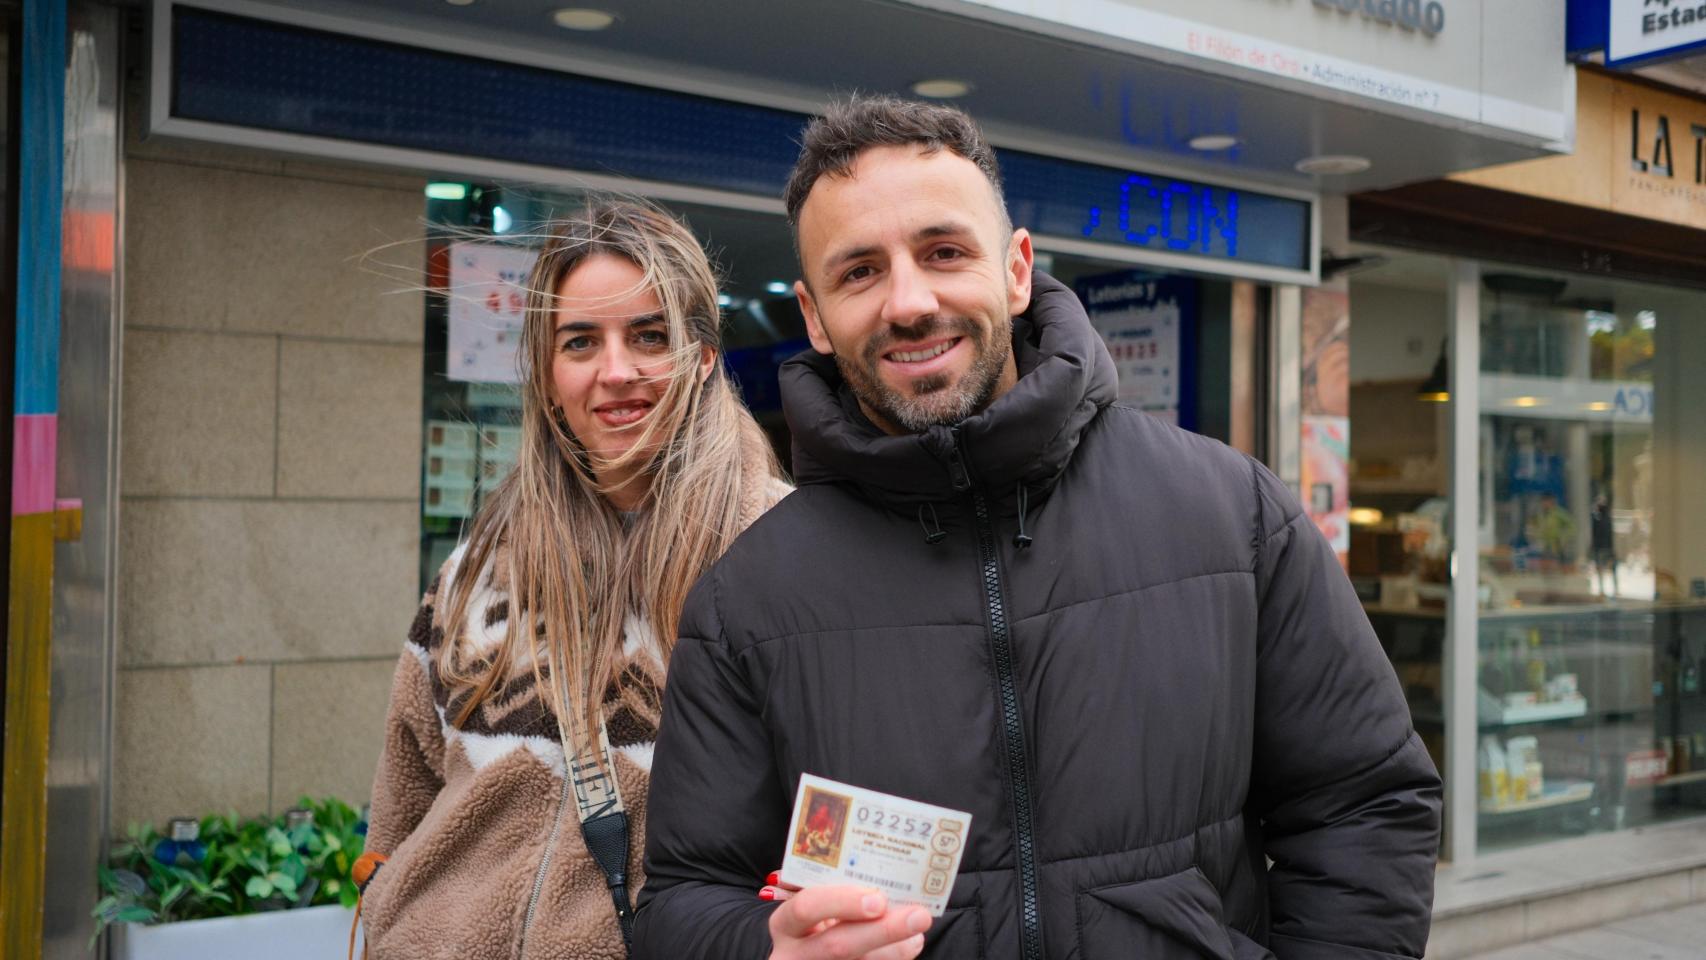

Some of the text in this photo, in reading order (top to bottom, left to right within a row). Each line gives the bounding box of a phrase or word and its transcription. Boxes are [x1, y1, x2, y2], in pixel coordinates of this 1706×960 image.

[1311, 0, 1444, 34] ado
[1631, 108, 1673, 178] LA
[1119, 173, 1238, 257] CON
[857, 807, 932, 837] 02252
